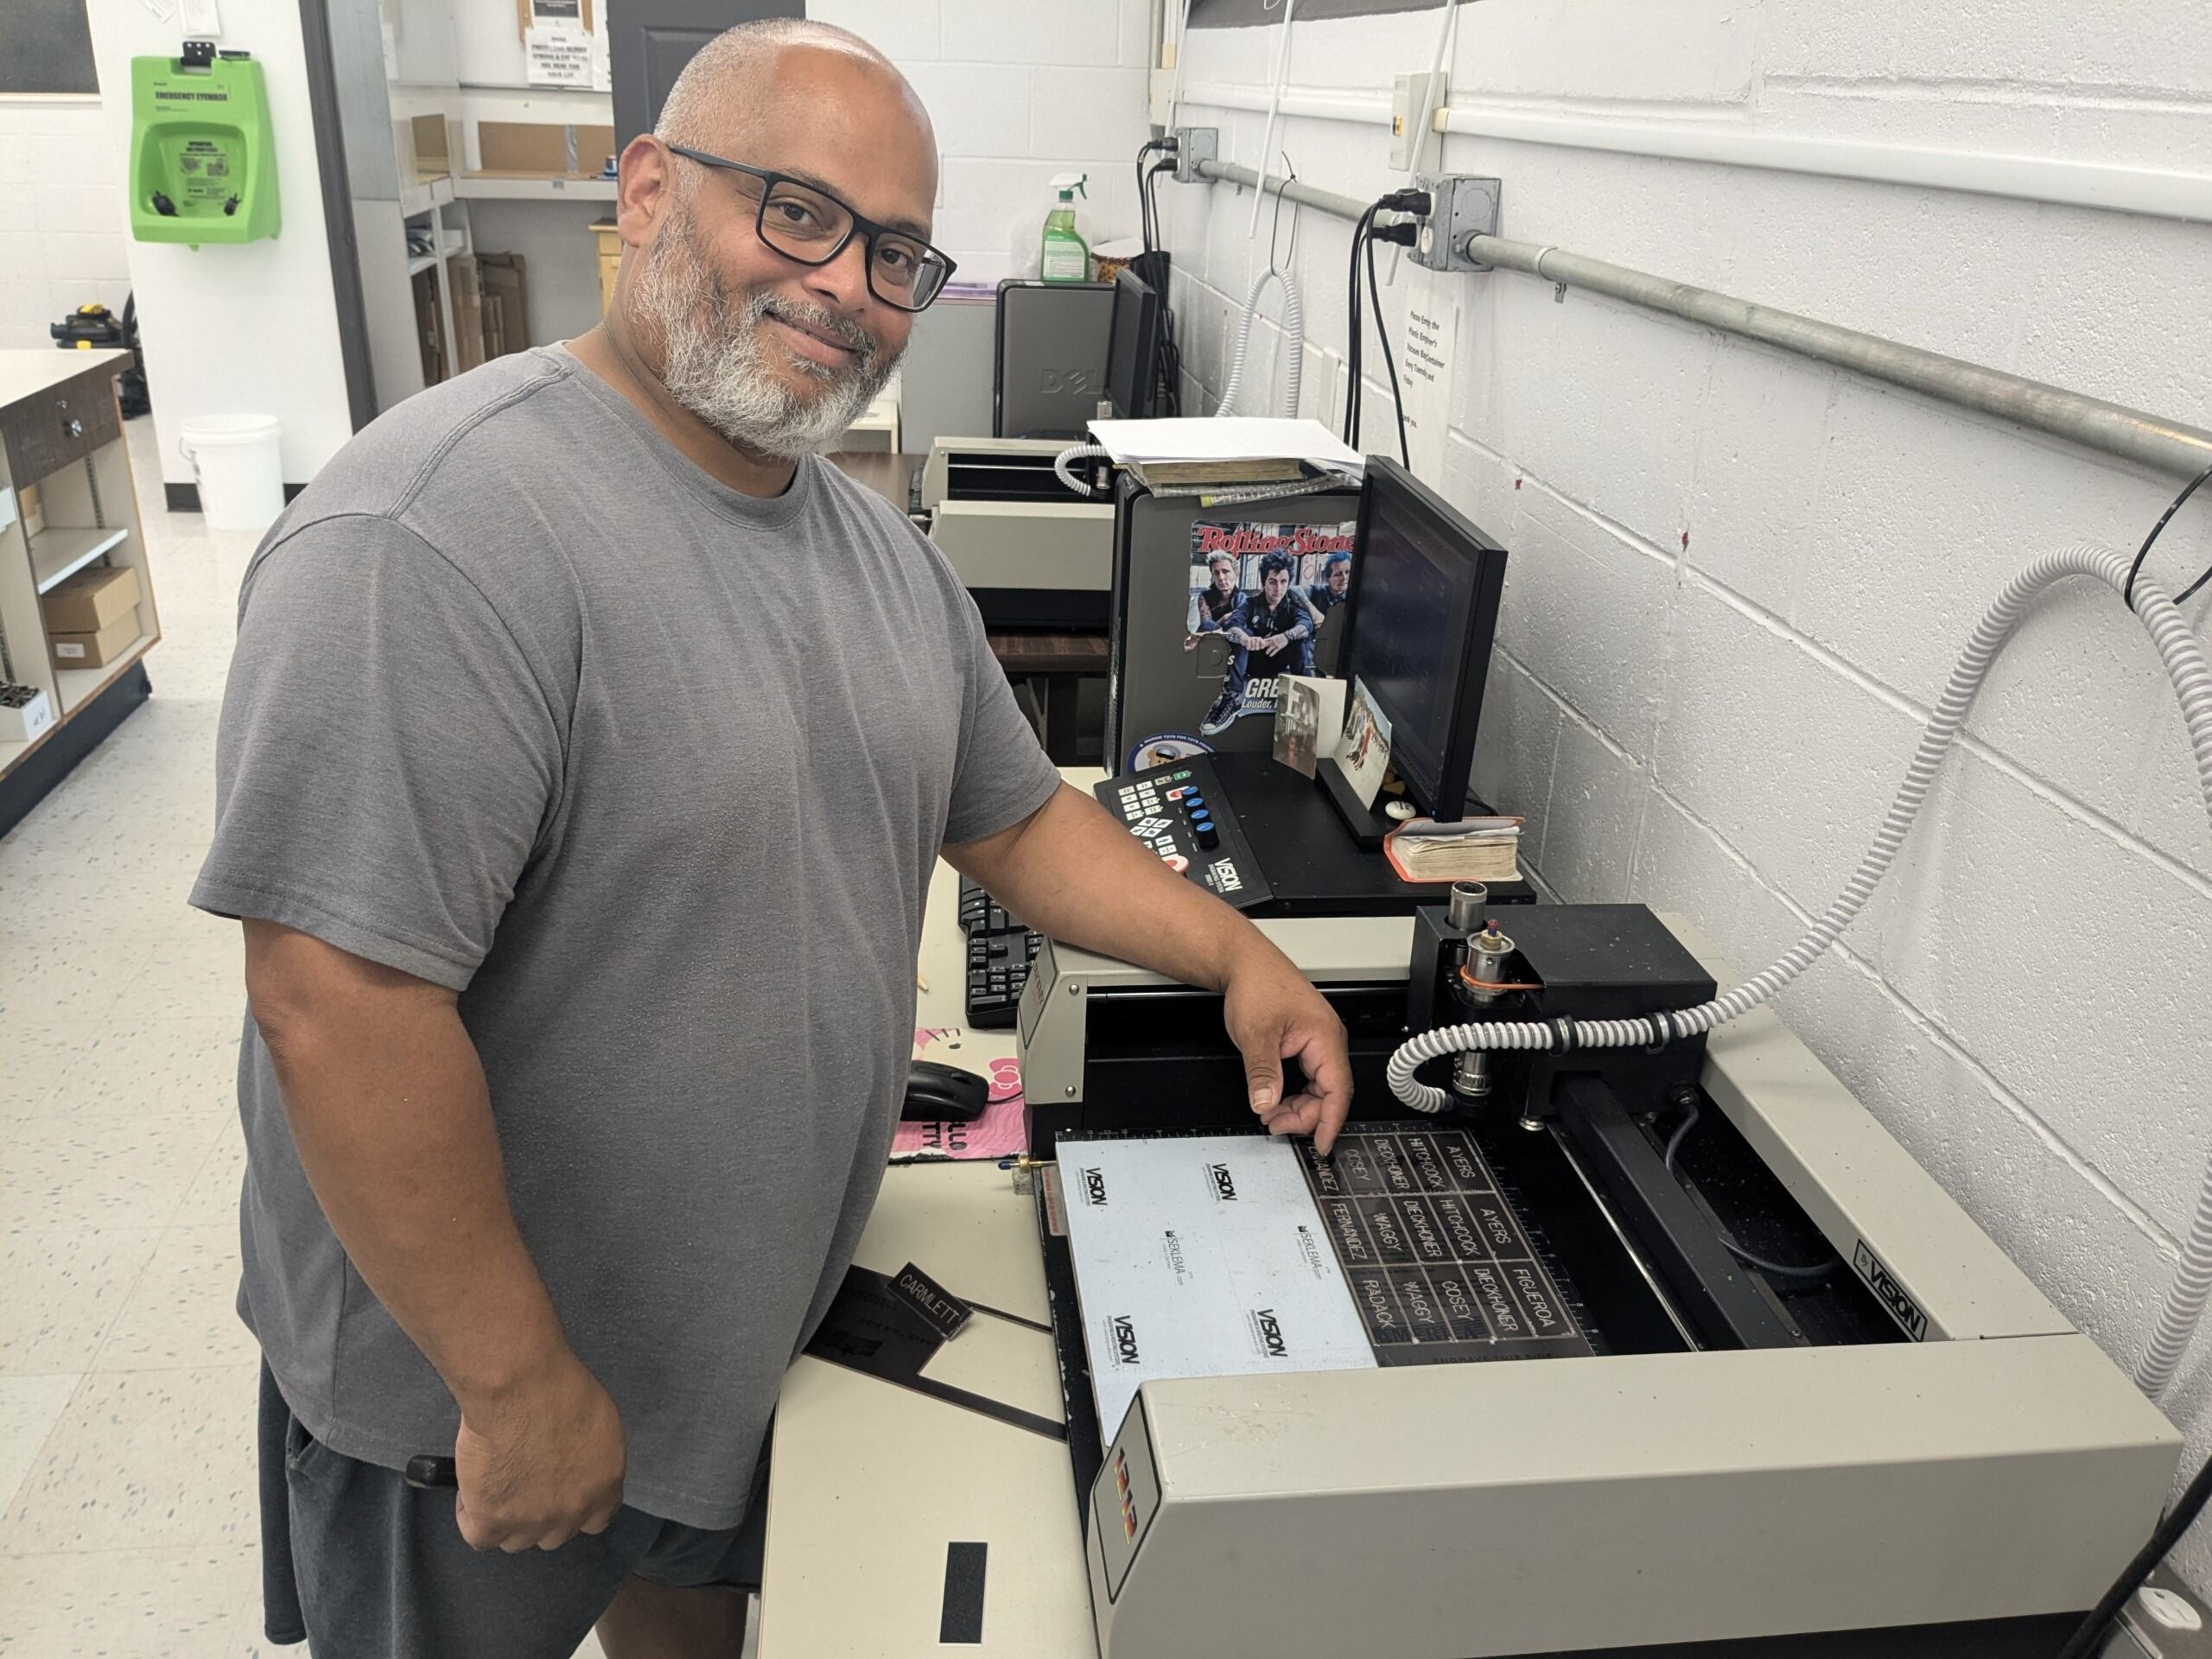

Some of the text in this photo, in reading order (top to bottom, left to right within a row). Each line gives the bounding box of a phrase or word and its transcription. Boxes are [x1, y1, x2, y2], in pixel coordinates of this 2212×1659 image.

[156, 91, 227, 101] EMERGENCY EYEWASH
[1040, 369, 1103, 395] DEL
[1198, 527, 1355, 559] Rolling Stone
[1242, 698, 1272, 709] Louder,
[1214, 857, 1243, 892] VISION
[948, 1122, 968, 1150] LLO
[1212, 1163, 1237, 1201] VISION
[1306, 1141, 1339, 1192] ENANDEZ
[1344, 1148, 1371, 1181] COSEY
[1374, 1139, 1410, 1189] DIECKHONER
[1408, 1138, 1446, 1188] HITCHCOCK
[1446, 1146, 1476, 1179] AYERS
[1086, 1167, 1108, 1206] VISION
[1331, 1203, 1368, 1260] FERNANDEZ
[1373, 1212, 1403, 1252] WAGGY
[1403, 1200, 1443, 1257] DIECKHONER
[1440, 1199, 1481, 1255] HITCHCOCK
[1480, 1208, 1511, 1244] AYERS
[1167, 1238, 1186, 1274] SEKLEMA
[1300, 1233, 1323, 1268] SEKLEMA
[900, 1274, 960, 1324] CARMLETT
[1403, 1281, 1436, 1324] WAGGY
[1441, 1281, 1475, 1320] COSEY
[1473, 1268, 1519, 1332] DIECKHONER
[1512, 1268, 1556, 1327] FIGUEROA
[1860, 1252, 1921, 1332] By VISION
[1114, 1315, 1141, 1364] VISION
[1257, 1308, 1288, 1357] VISION
